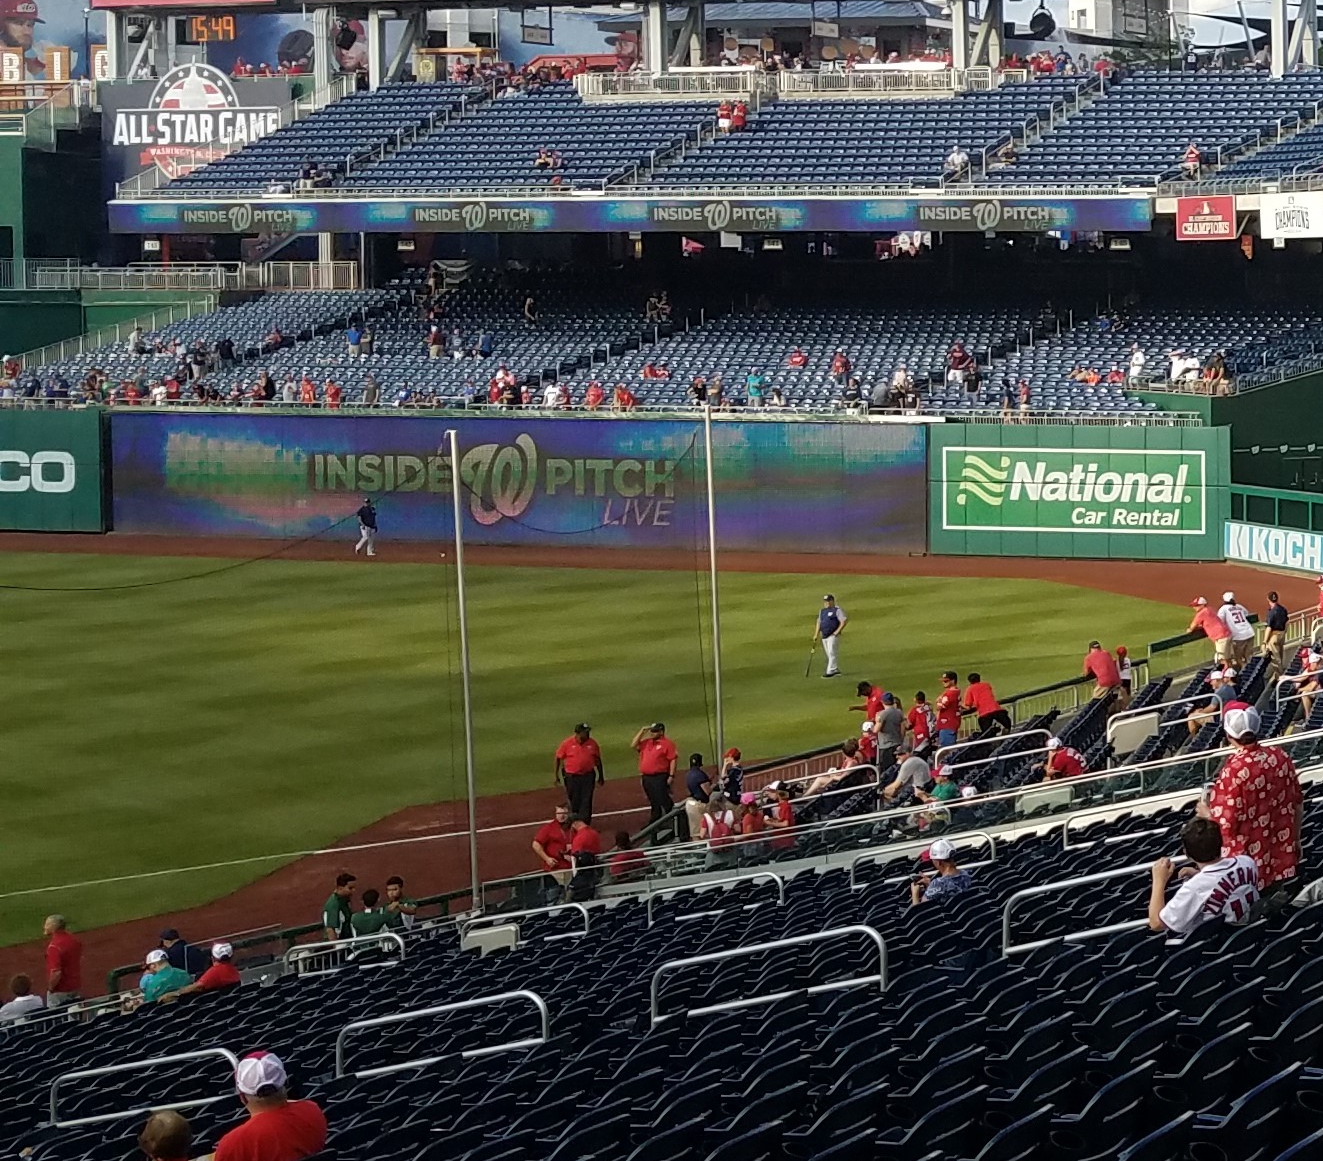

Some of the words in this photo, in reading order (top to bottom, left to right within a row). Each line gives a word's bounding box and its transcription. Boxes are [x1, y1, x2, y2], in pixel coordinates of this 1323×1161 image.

[190, 15, 236, 42] 15:49
[112, 111, 156, 146] ALL
[157, 111, 213, 144] STAR
[219, 110, 280, 144] GAME
[183, 210, 227, 223] INSIDE
[254, 210, 293, 223] PITCH
[415, 210, 460, 223] INSIDE
[489, 210, 529, 223] PITCH
[653, 208, 702, 221] INSIDE
[732, 208, 776, 221] PITCH
[919, 207, 970, 220] INSIDE
[1003, 207, 1049, 220] PITCH
[1275, 209, 1310, 230] CHAMPIONS
[1182, 221, 1230, 235] CHAMPIONS
[312, 453, 452, 491] INSIDE
[546, 457, 675, 499] PITCH
[602, 499, 673, 527] LIVE
[1071, 506, 1107, 526] Car
[1111, 506, 1180, 526] Rental
[1231, 611, 1246, 625] 31
[1203, 867, 1258, 915] ZIMMERM
